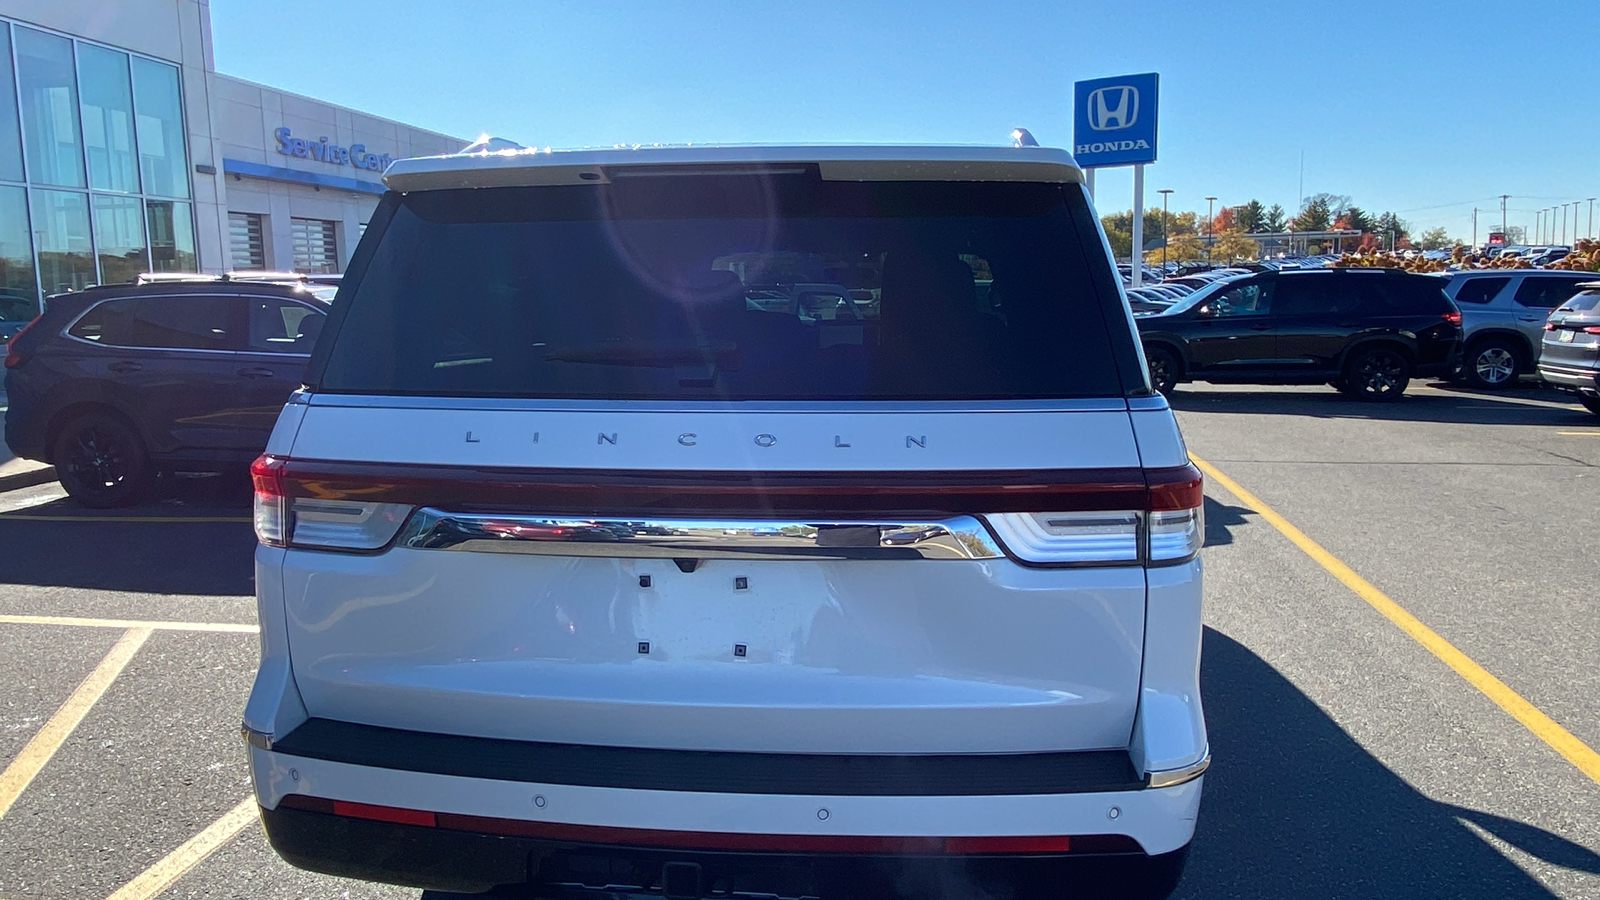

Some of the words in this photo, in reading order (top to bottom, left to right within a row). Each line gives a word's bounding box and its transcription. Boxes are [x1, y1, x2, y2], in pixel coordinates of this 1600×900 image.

[275, 127, 349, 166] Service
[1075, 139, 1150, 154] HONDA
[466, 431, 926, 448] LINCOLN
